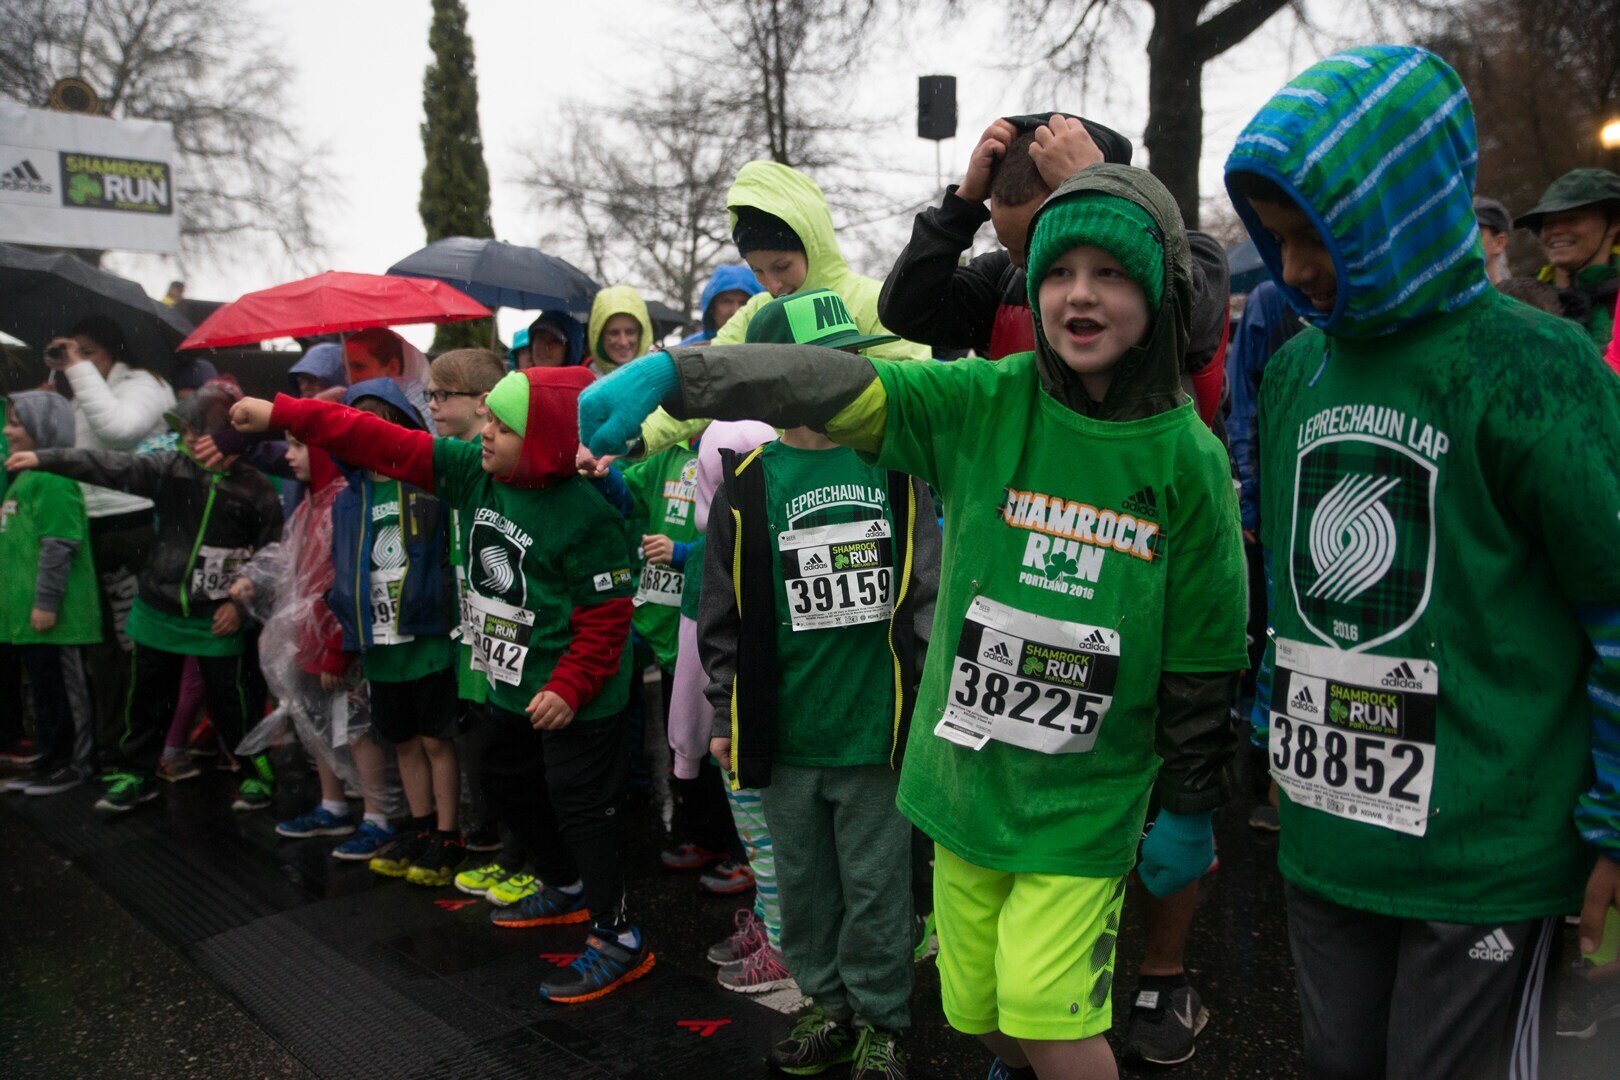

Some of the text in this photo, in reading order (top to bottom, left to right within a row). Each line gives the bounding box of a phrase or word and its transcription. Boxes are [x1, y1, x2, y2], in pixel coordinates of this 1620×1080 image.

[66, 155, 164, 180] SHAMROCK
[104, 176, 168, 206] RUN
[813, 295, 855, 331] NIK
[1297, 404, 1449, 460] LEPRECHAUN LAP
[785, 484, 865, 519] LEPRECHAUN
[1122, 498, 1160, 519] adidas
[865, 529, 886, 538] adidas
[1004, 489, 1158, 559] SHAMROCK
[514, 529, 534, 548] LAP
[832, 541, 876, 555] SHAMROCK
[803, 563, 828, 571] adidas
[849, 549, 878, 564] RUN
[641, 568, 684, 595] 36823
[791, 569, 890, 614] 39159
[1019, 571, 1095, 600] PORTLAND 2016
[495, 624, 518, 640] RUN
[1333, 619, 1359, 641] 2016
[983, 650, 1014, 667] adidas
[1026, 644, 1090, 666] SHAMROCK
[1079, 640, 1111, 653] adidas
[1045, 659, 1088, 683] RUN
[1381, 676, 1423, 690] adidas
[954, 661, 1104, 735] 38225
[1291, 698, 1319, 714] adidas
[1330, 684, 1397, 709] SHAMROCK
[1350, 701, 1398, 728] RUN
[1272, 716, 1425, 804] 38852
